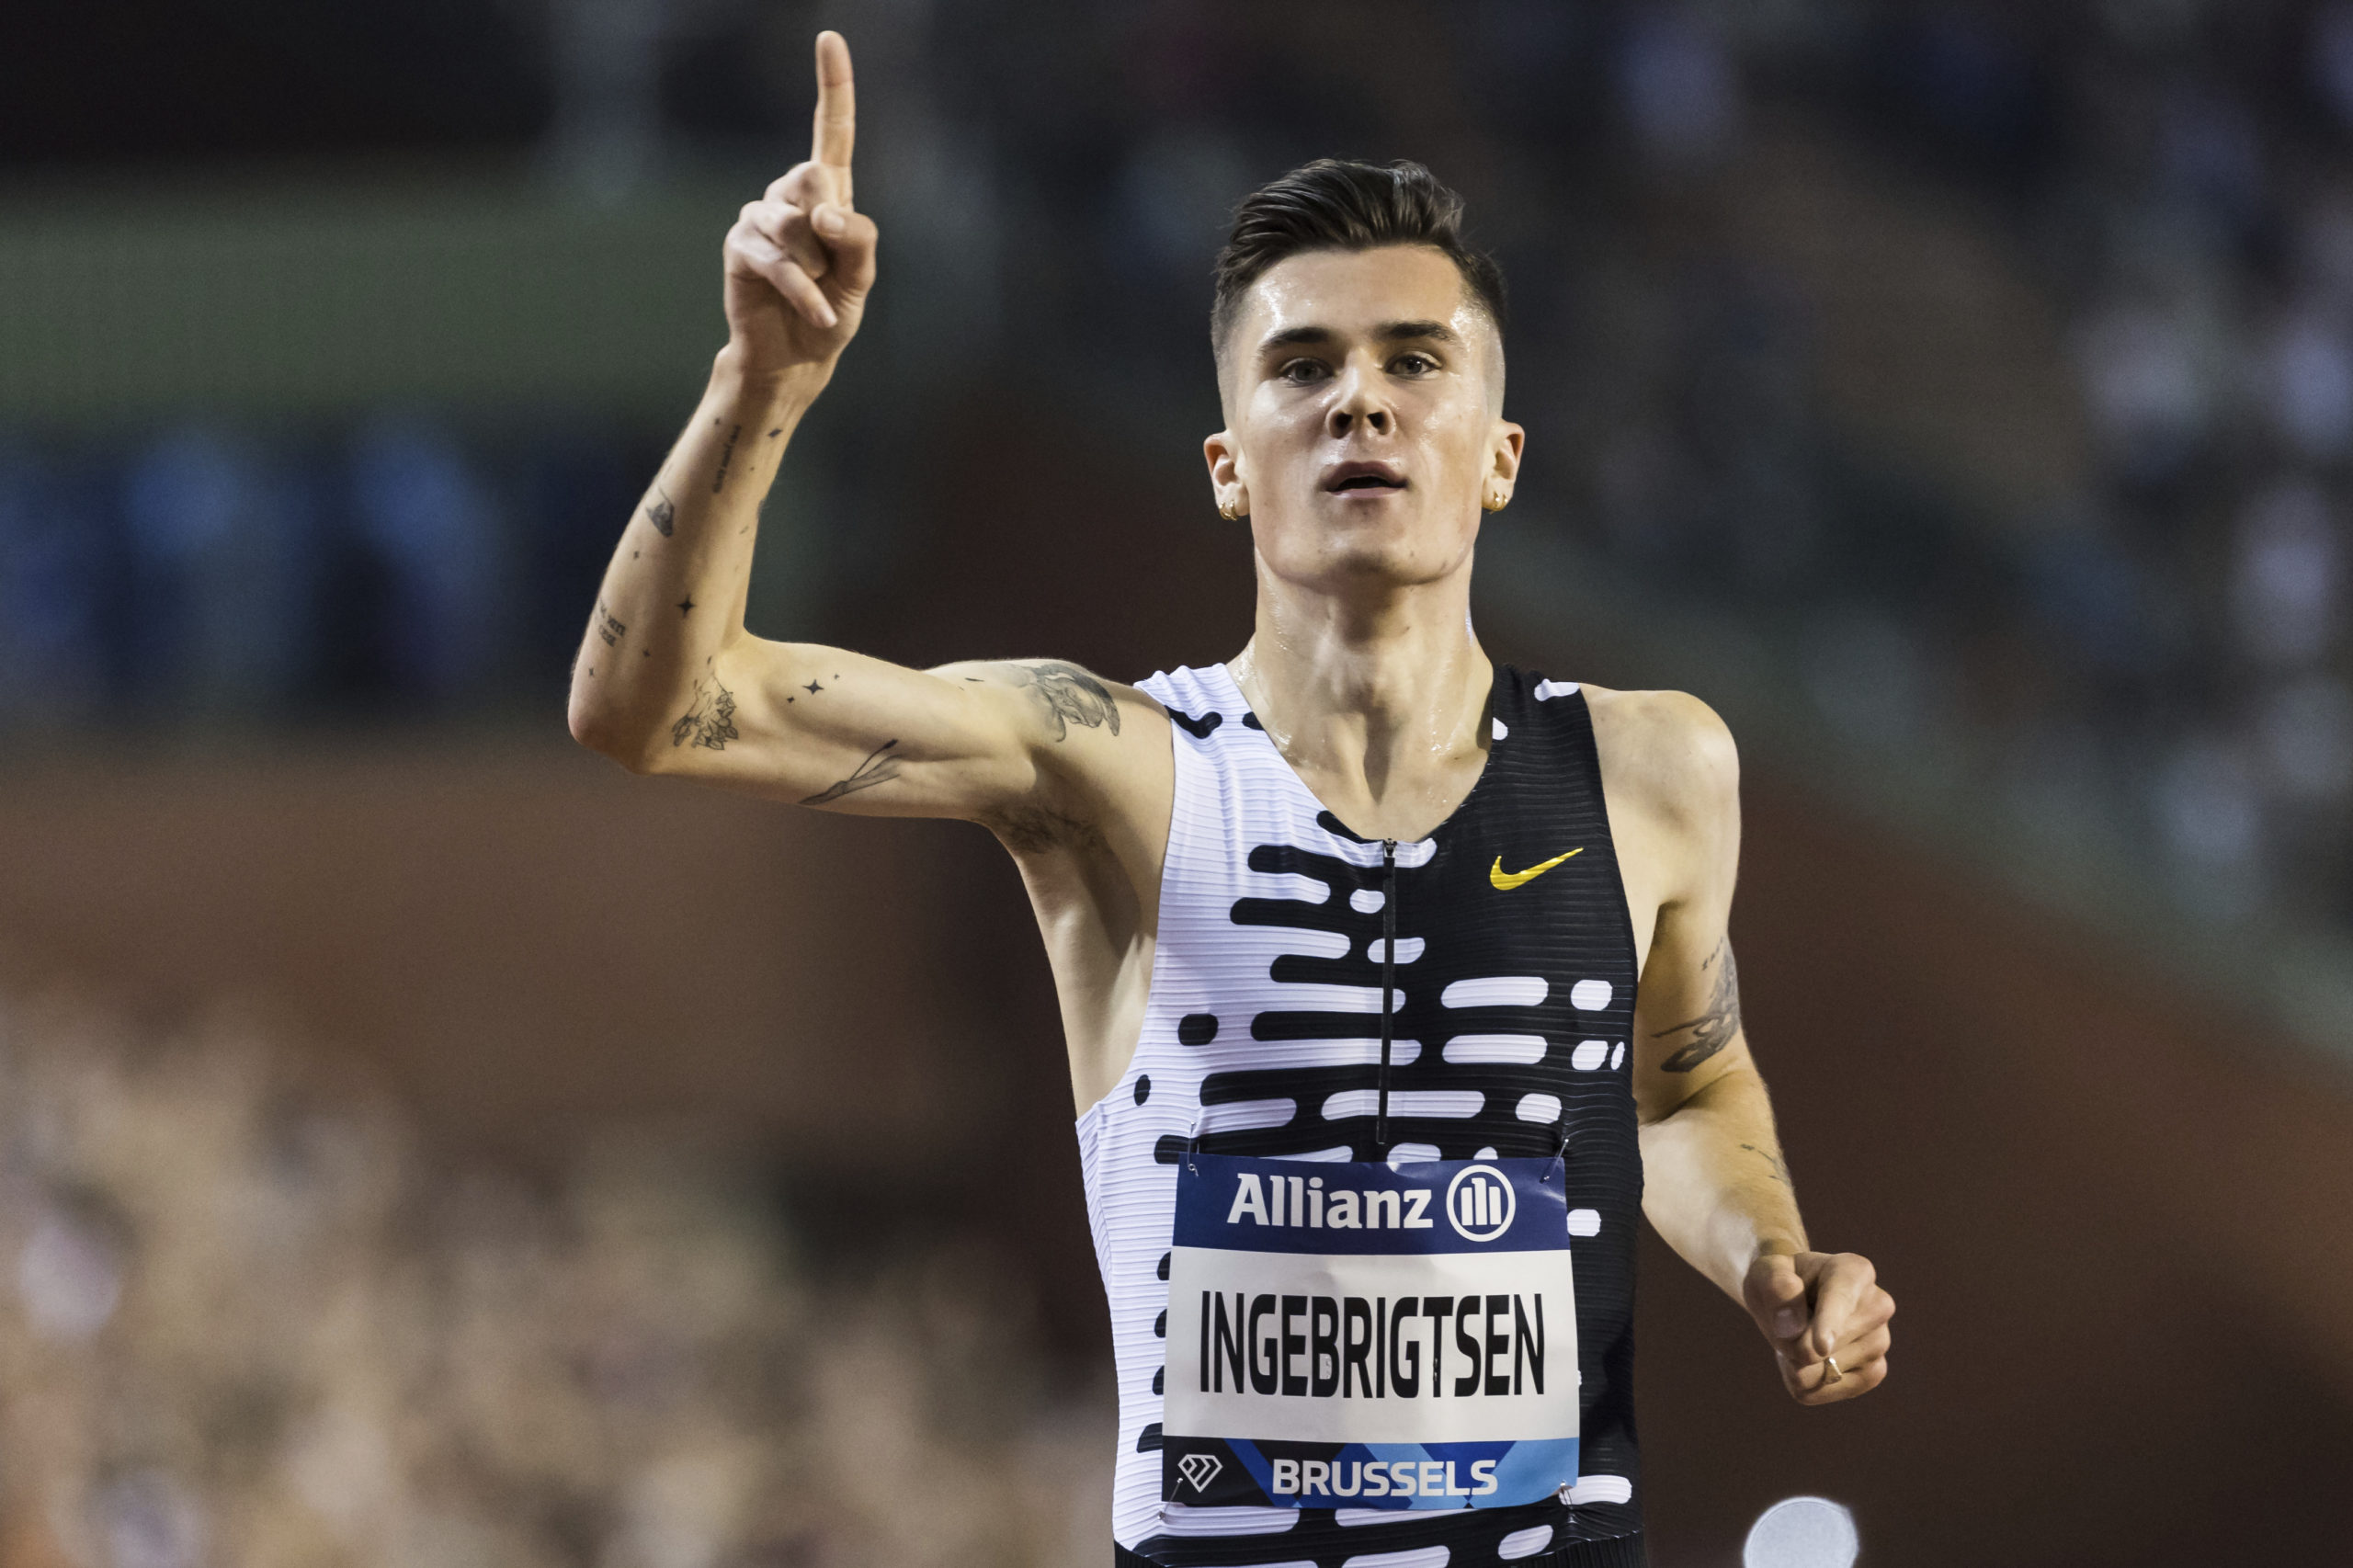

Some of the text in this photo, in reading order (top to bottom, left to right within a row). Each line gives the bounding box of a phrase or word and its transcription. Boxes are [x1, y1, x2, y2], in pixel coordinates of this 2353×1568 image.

[1226, 1173, 1434, 1230] Allianz
[1199, 1290, 1545, 1399] INGEBRIGTSEN
[1272, 1459, 1499, 1498] BRUSSELS
